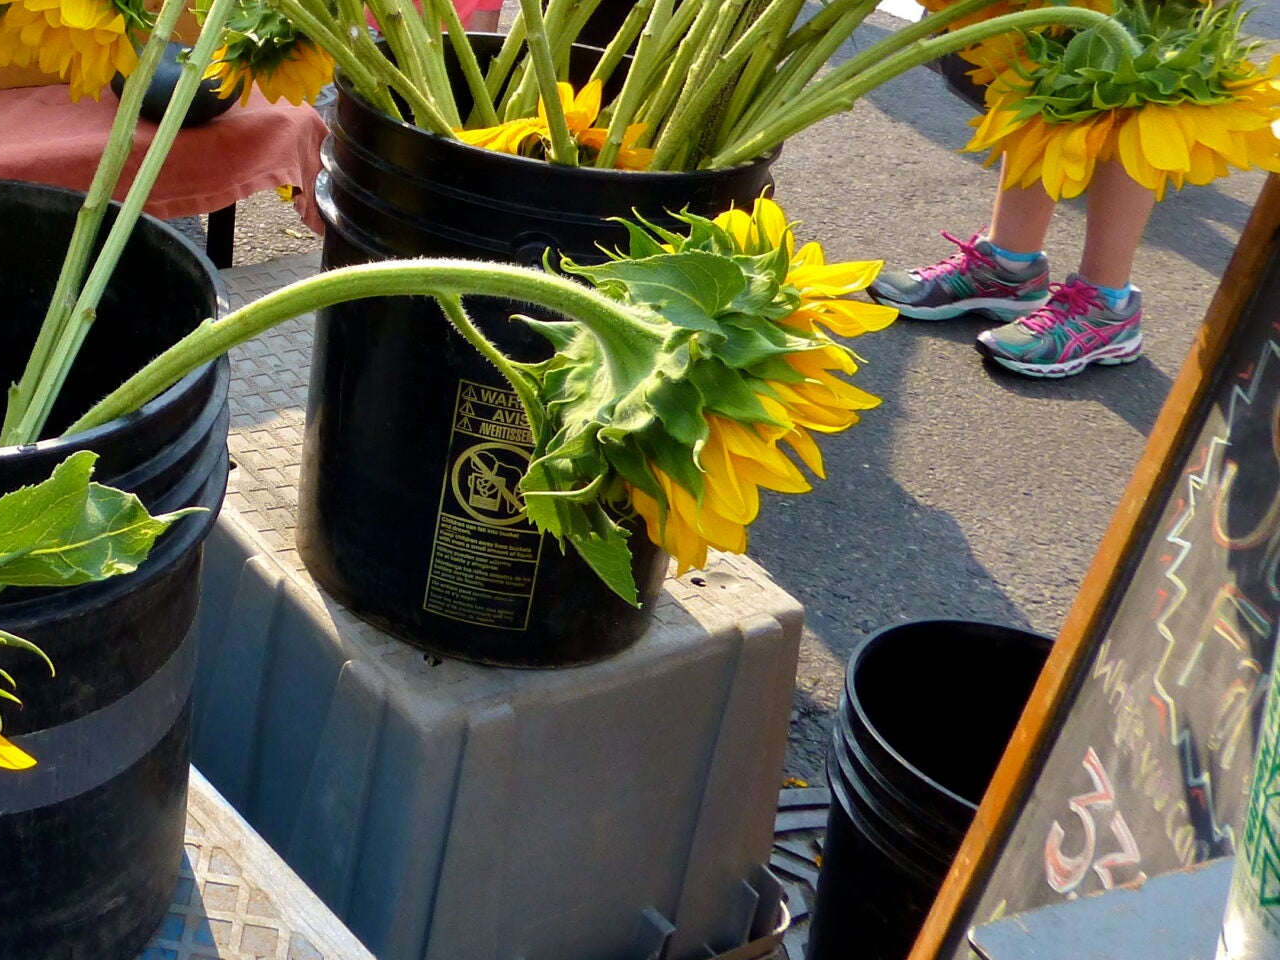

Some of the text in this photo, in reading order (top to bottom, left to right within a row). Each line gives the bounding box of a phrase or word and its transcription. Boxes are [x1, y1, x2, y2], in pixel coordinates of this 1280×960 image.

[480, 388, 521, 409] WAR
[492, 409, 530, 427] AVIS
[479, 422, 533, 443] AVERTISSE
